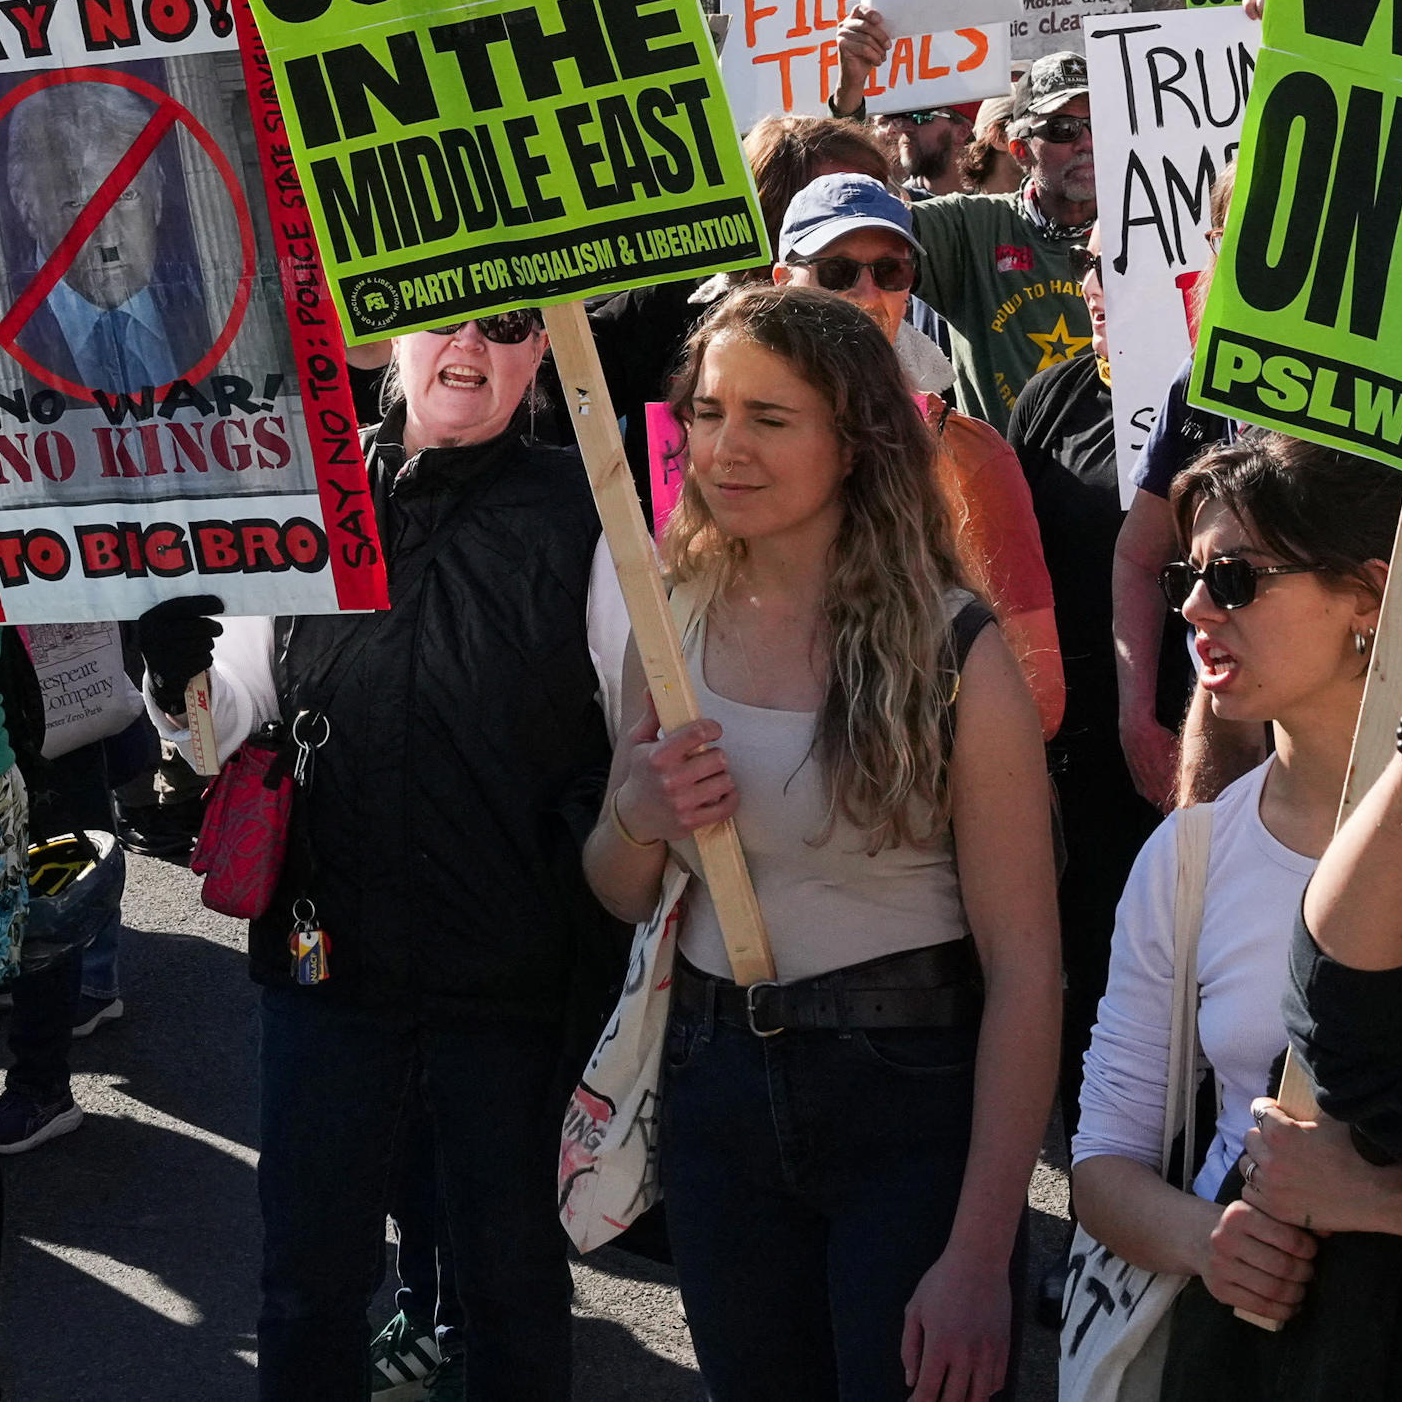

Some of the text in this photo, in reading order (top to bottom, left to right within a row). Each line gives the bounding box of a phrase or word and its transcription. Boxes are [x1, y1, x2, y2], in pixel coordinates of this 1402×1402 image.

[280, 28, 439, 149] IN
[310, 78, 725, 264] MIDDLE EAST
[280, 220, 327, 327] POLICE
[400, 211, 754, 311] PARTY FOR SOCIALISM & LIBERATION
[1023, 282, 1046, 301] TO
[363, 292, 390, 313] PSL
[93, 373, 286, 425] WAR!
[97, 415, 293, 482] KINGS
[321, 408, 355, 466] NO
[73, 518, 193, 580] BIG
[194, 515, 330, 577] BRO
[333, 475, 380, 570] SAY
